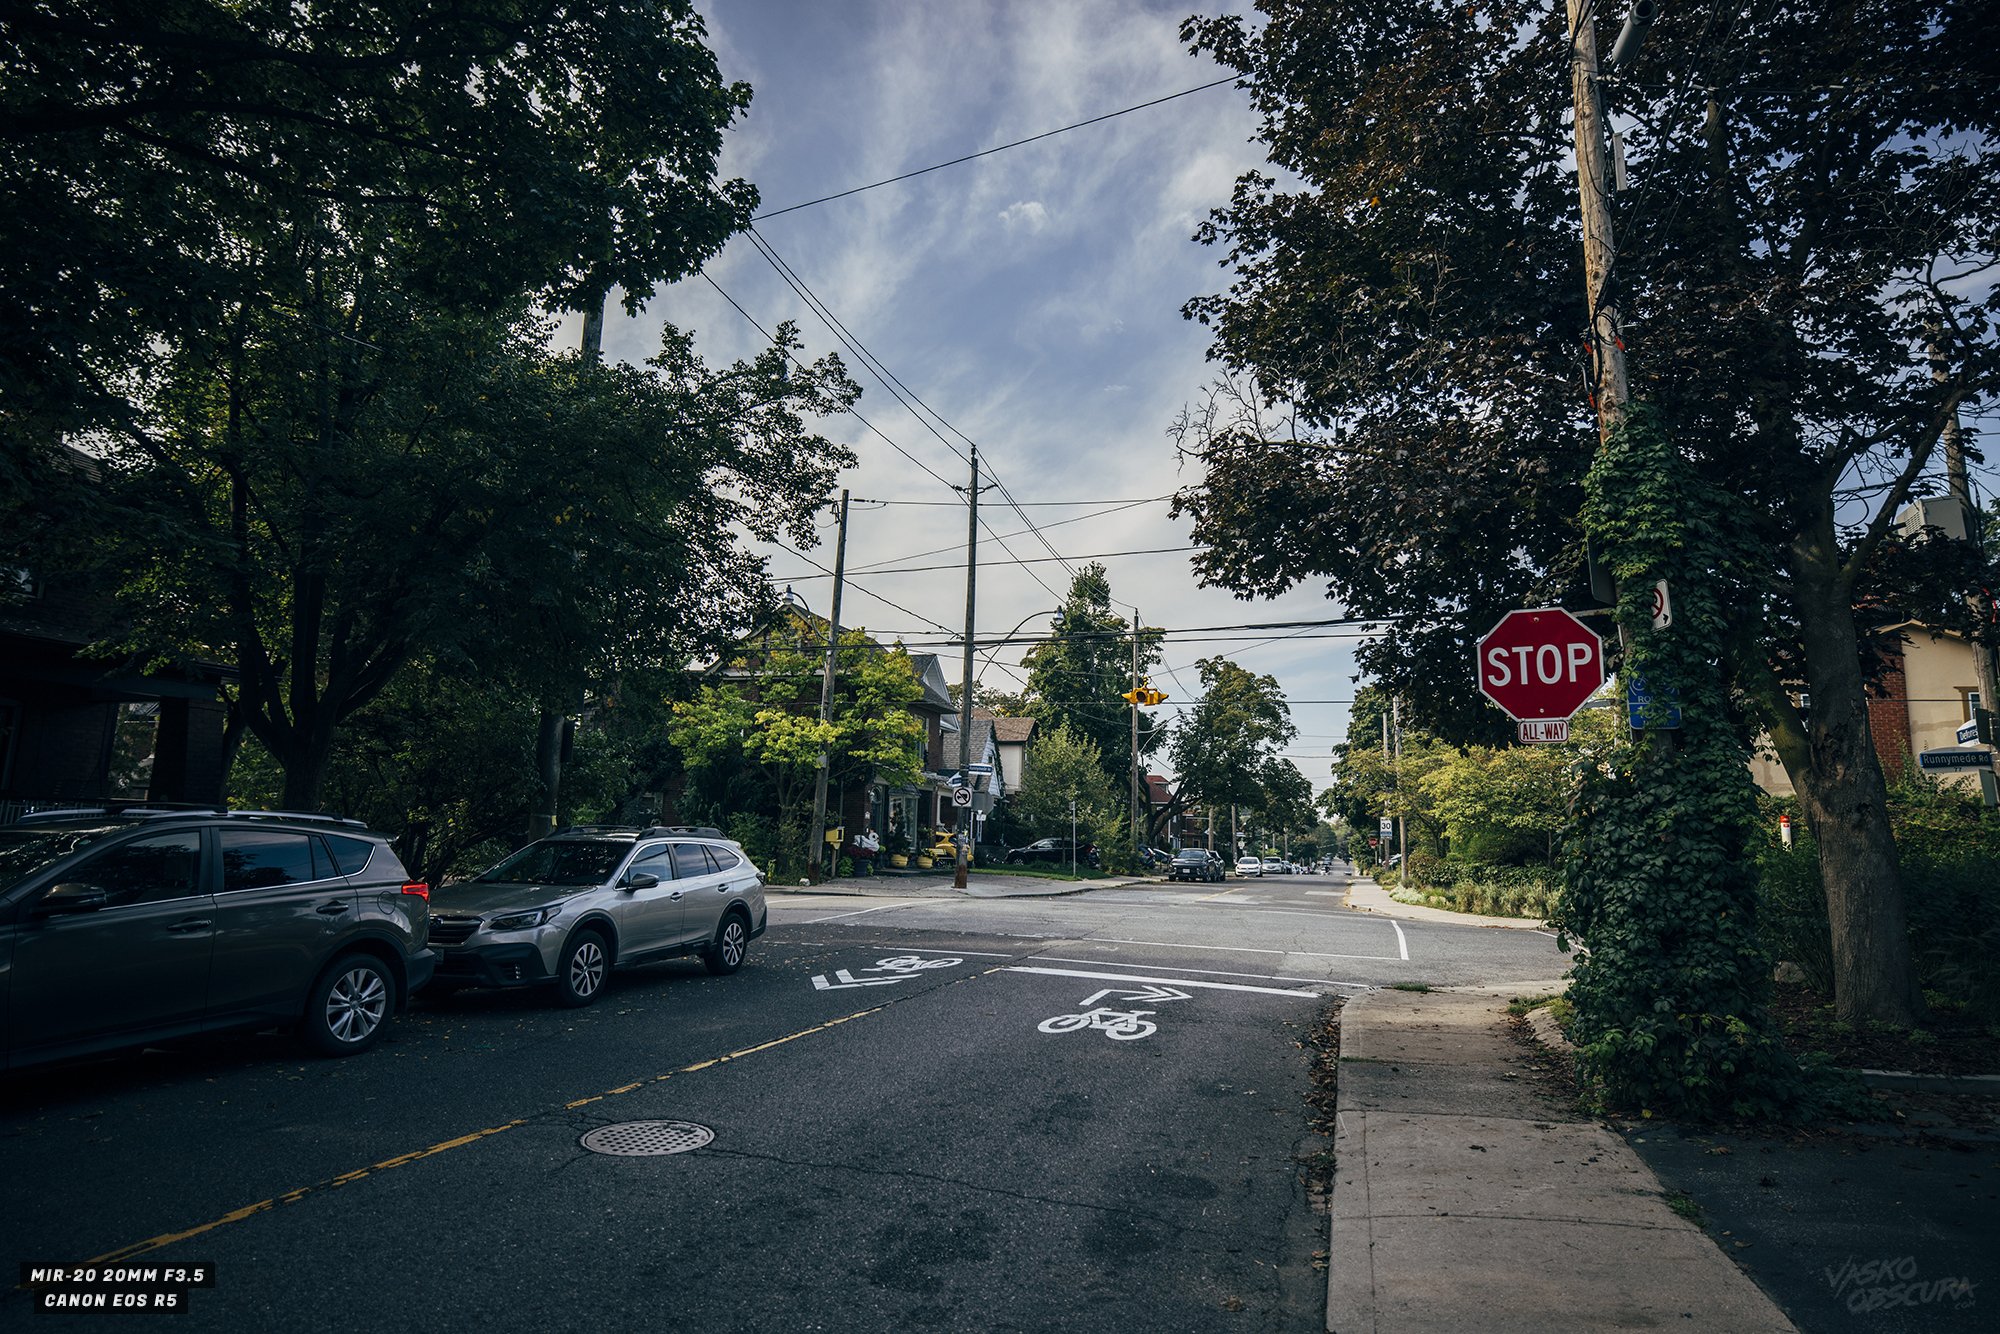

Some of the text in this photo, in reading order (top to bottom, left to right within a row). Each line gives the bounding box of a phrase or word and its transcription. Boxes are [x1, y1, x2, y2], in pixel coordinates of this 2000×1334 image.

[1487, 642, 1593, 687] STOP
[1522, 722, 1565, 740] ALL-WAY
[1923, 753, 1989, 766] Runnymede Rd
[1381, 822, 1391, 830] 30
